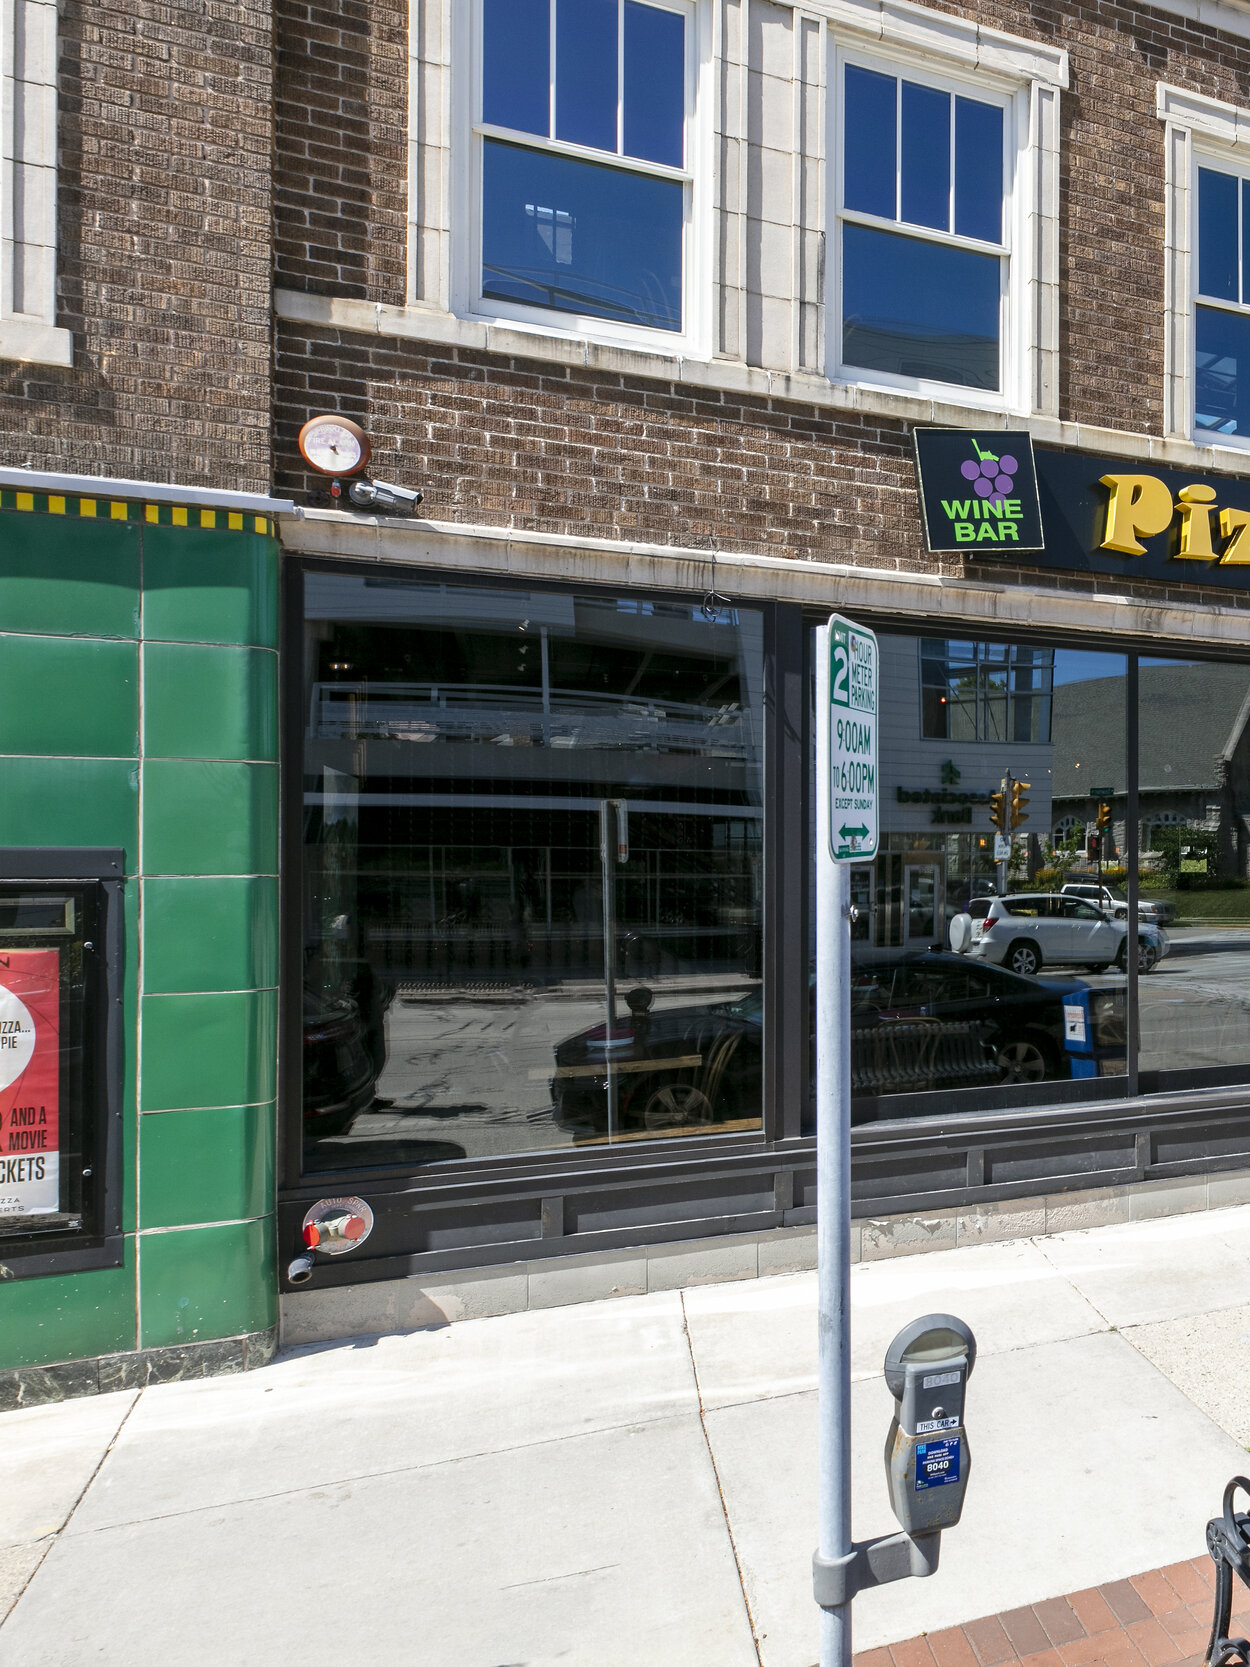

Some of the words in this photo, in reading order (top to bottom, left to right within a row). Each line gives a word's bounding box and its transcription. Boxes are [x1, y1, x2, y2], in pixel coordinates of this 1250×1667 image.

[940, 499, 1024, 519] WINE
[954, 521, 1020, 542] BAR
[853, 640, 873, 665] HOUR
[833, 646, 849, 703] 2
[851, 660, 873, 688] METER
[851, 684, 875, 711] PARKING
[837, 718, 871, 755] 9:00AM
[833, 766, 840, 788] TO
[841, 761, 875, 794] 6:00PM
[835, 798, 853, 809] EXCEPT
[854, 798, 873, 810] SUNDAY
[1, 1036, 17, 1049] PIE
[10, 1107, 36, 1126] AND
[38, 1106, 47, 1124] A
[8, 1130, 47, 1151] MOVIE
[920, 1422, 935, 1431] THIS
[936, 1419, 950, 1429] CAR
[926, 1460, 949, 1472] 8040
